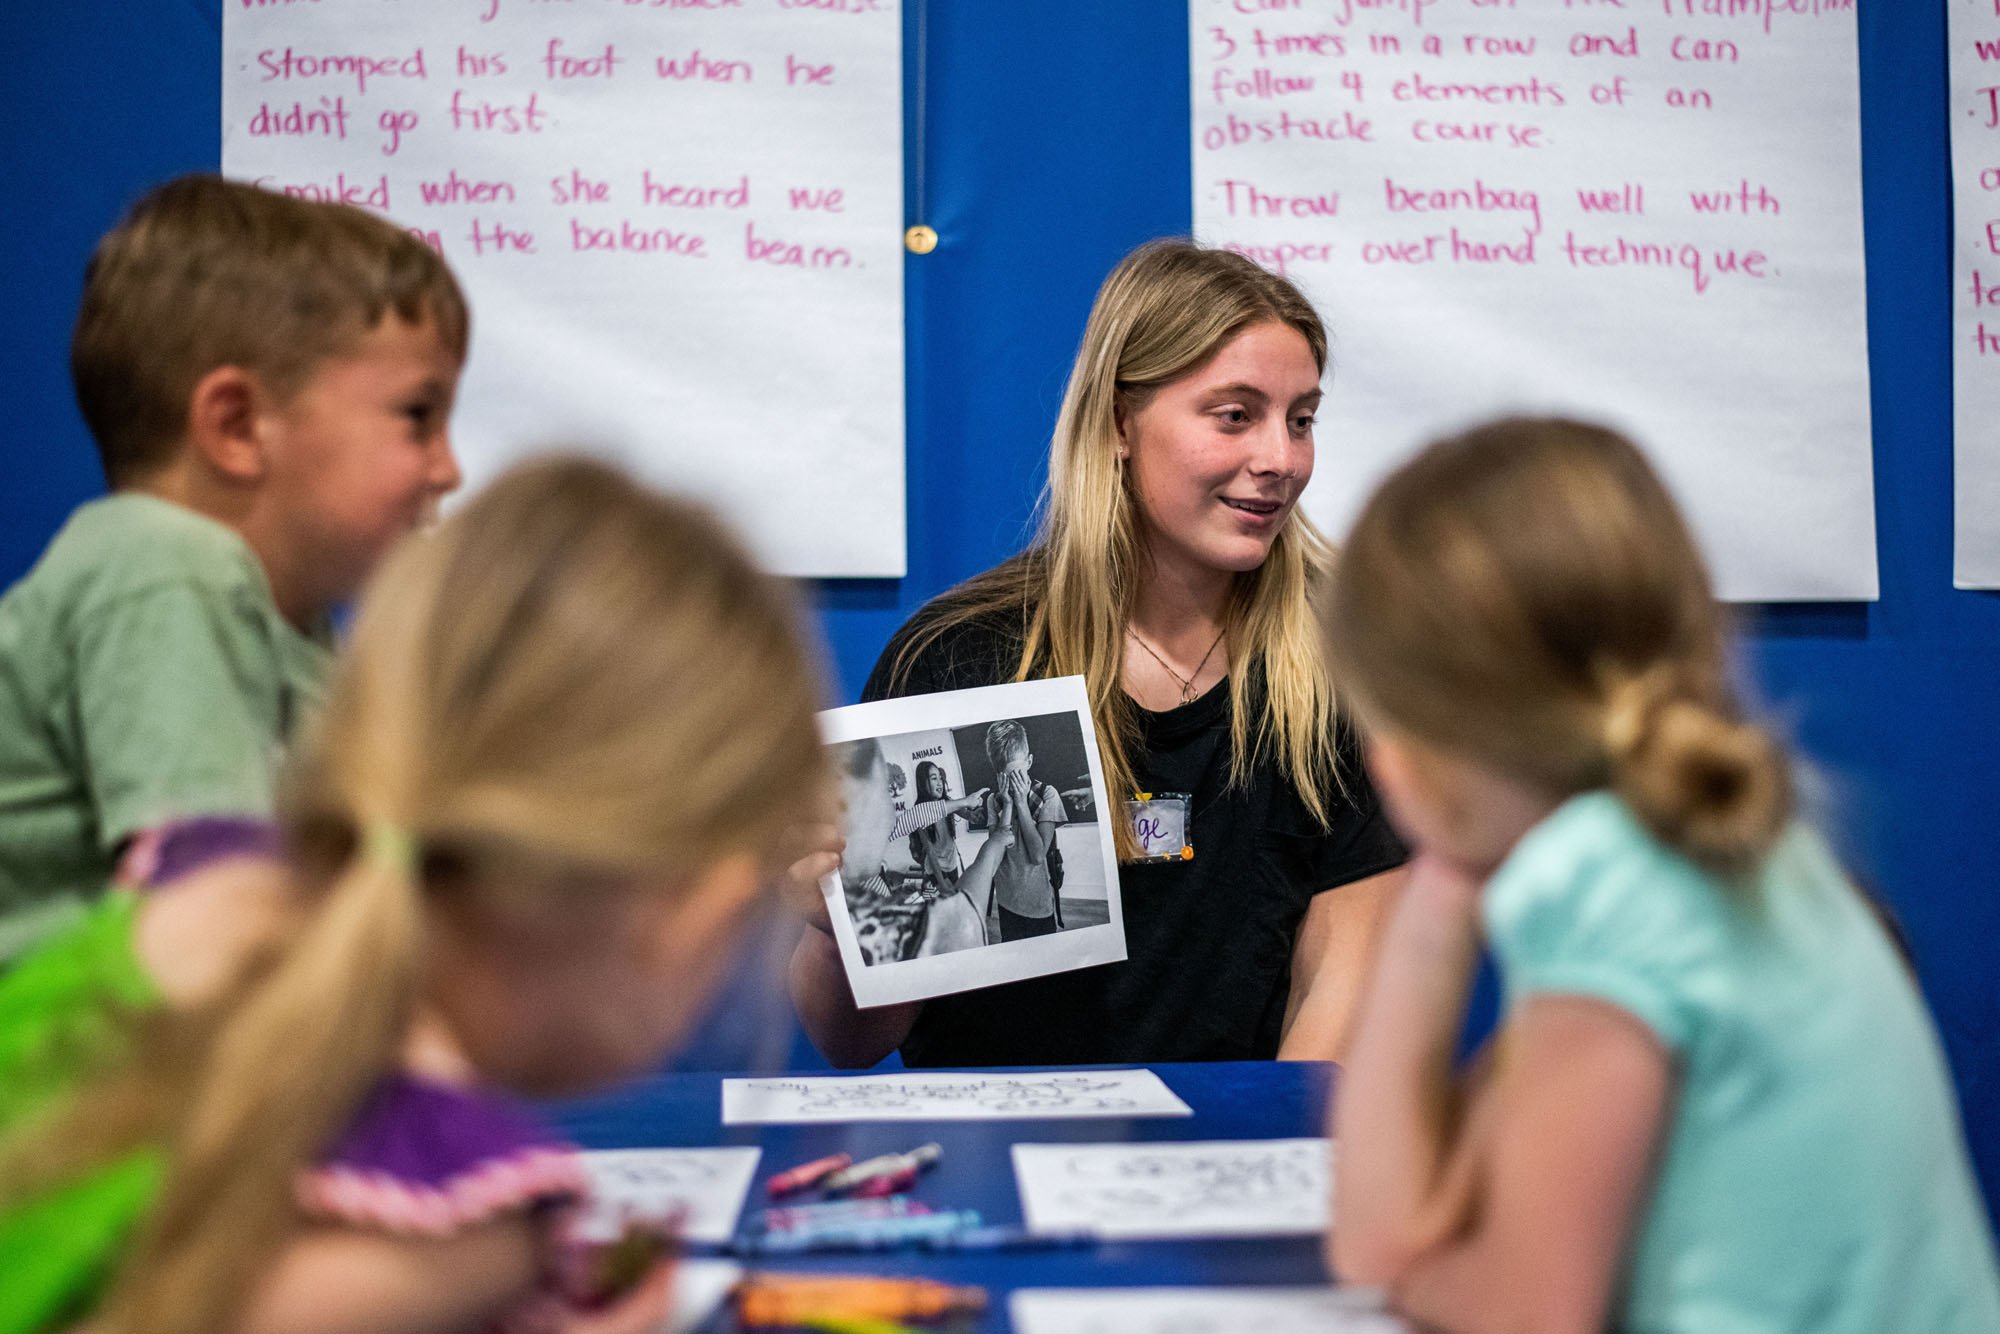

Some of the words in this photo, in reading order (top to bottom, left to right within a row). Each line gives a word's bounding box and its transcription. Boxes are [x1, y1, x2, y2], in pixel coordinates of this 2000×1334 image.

[1208, 27, 1236, 60] 3
[1252, 28, 1346, 58] times
[1369, 33, 1401, 55] in
[1422, 33, 1442, 57] a
[1463, 33, 1536, 57] row
[1568, 26, 1640, 57] and
[1670, 34, 1740, 63] can
[257, 47, 427, 95] Stomped
[457, 45, 508, 77] his
[541, 37, 624, 79] foot
[655, 49, 752, 83] when
[785, 53, 834, 86] he
[1211, 67, 1315, 104] follow
[1341, 71, 1363, 101] 4
[1392, 73, 1566, 106] elements
[1590, 75, 1627, 106] of
[1665, 87, 1713, 110] an
[249, 96, 350, 140] didn't
[378, 110, 418, 156] go
[1204, 111, 1374, 151] obstacle
[420, 169, 516, 206] when
[550, 169, 609, 206] she
[643, 169, 749, 209] heard
[788, 186, 845, 212] we
[1214, 179, 1339, 217] Threw
[1384, 177, 1542, 236] beanbag
[1576, 184, 1645, 216] well
[1689, 178, 1782, 216] with
[467, 217, 536, 255] the
[569, 216, 706, 258] balance
[911, 745, 943, 761] ANIMALS
[895, 801, 907, 812] AK
